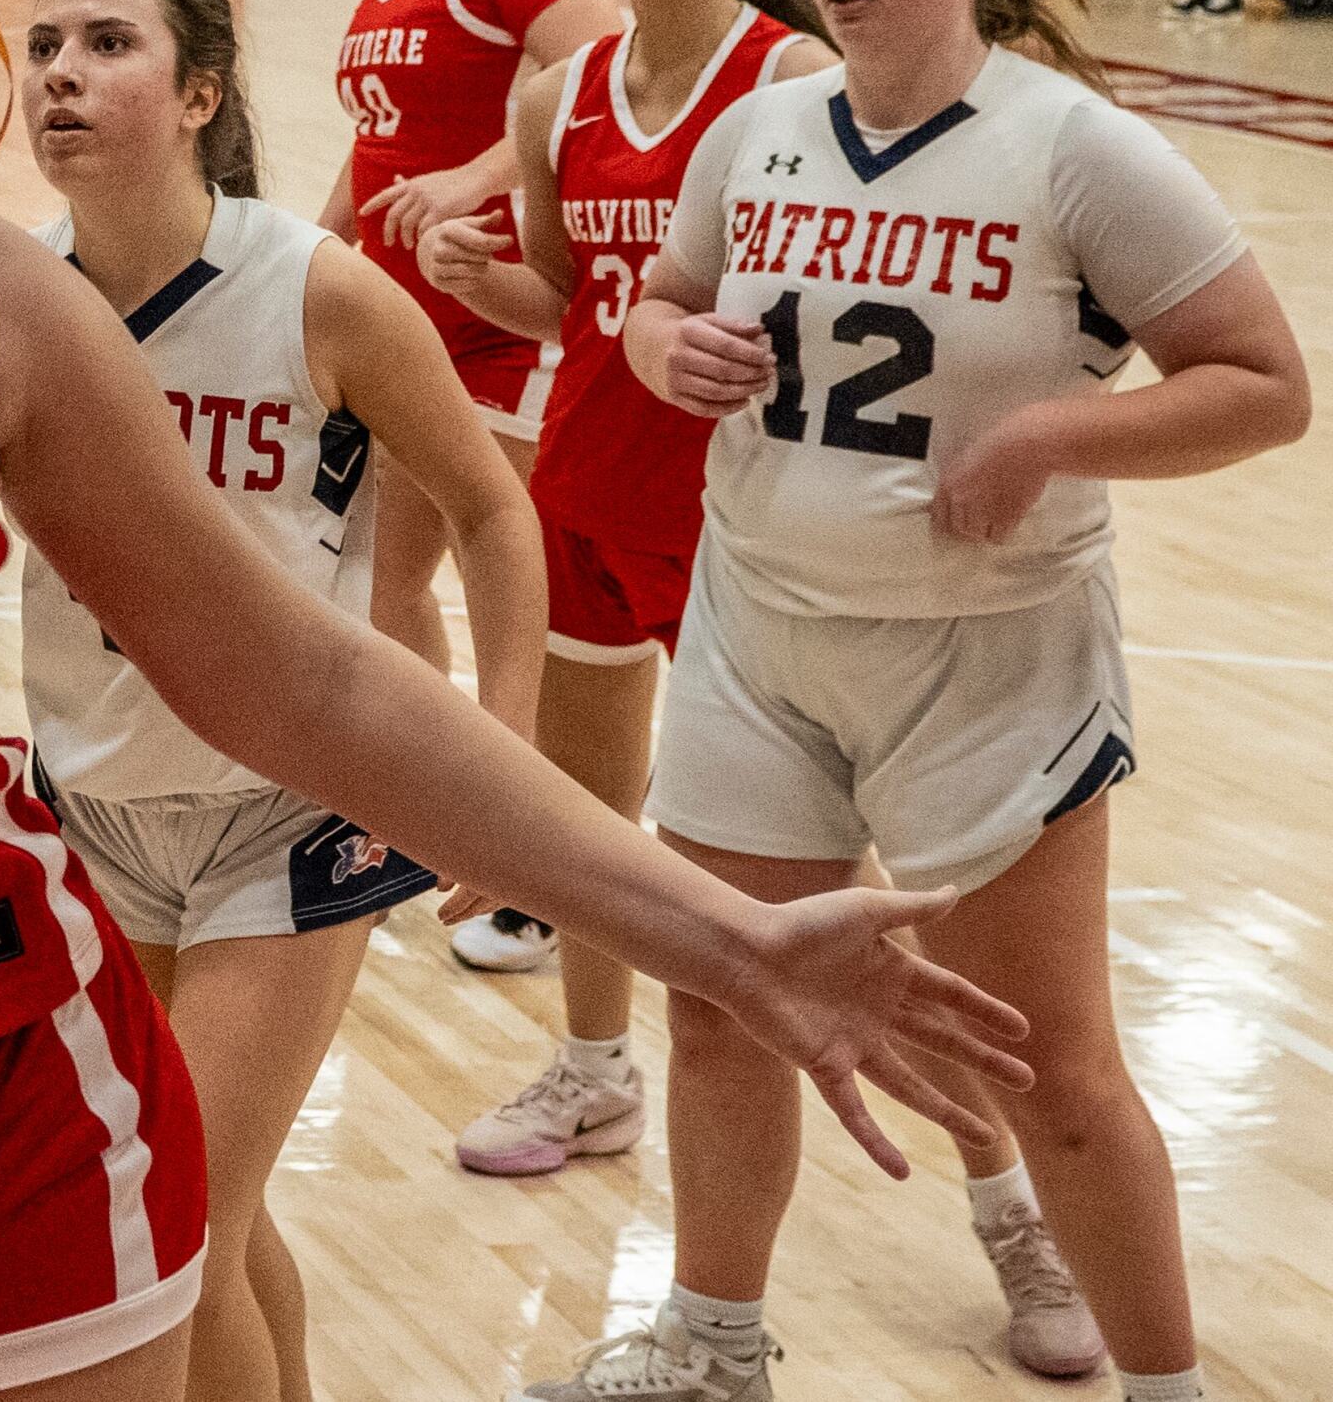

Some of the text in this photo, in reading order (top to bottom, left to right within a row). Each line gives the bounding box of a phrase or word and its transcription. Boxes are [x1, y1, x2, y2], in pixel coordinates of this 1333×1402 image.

[591, 254, 659, 338] 3
[724, 200, 1020, 303] PATRIOTS
[758, 290, 936, 461] 12
